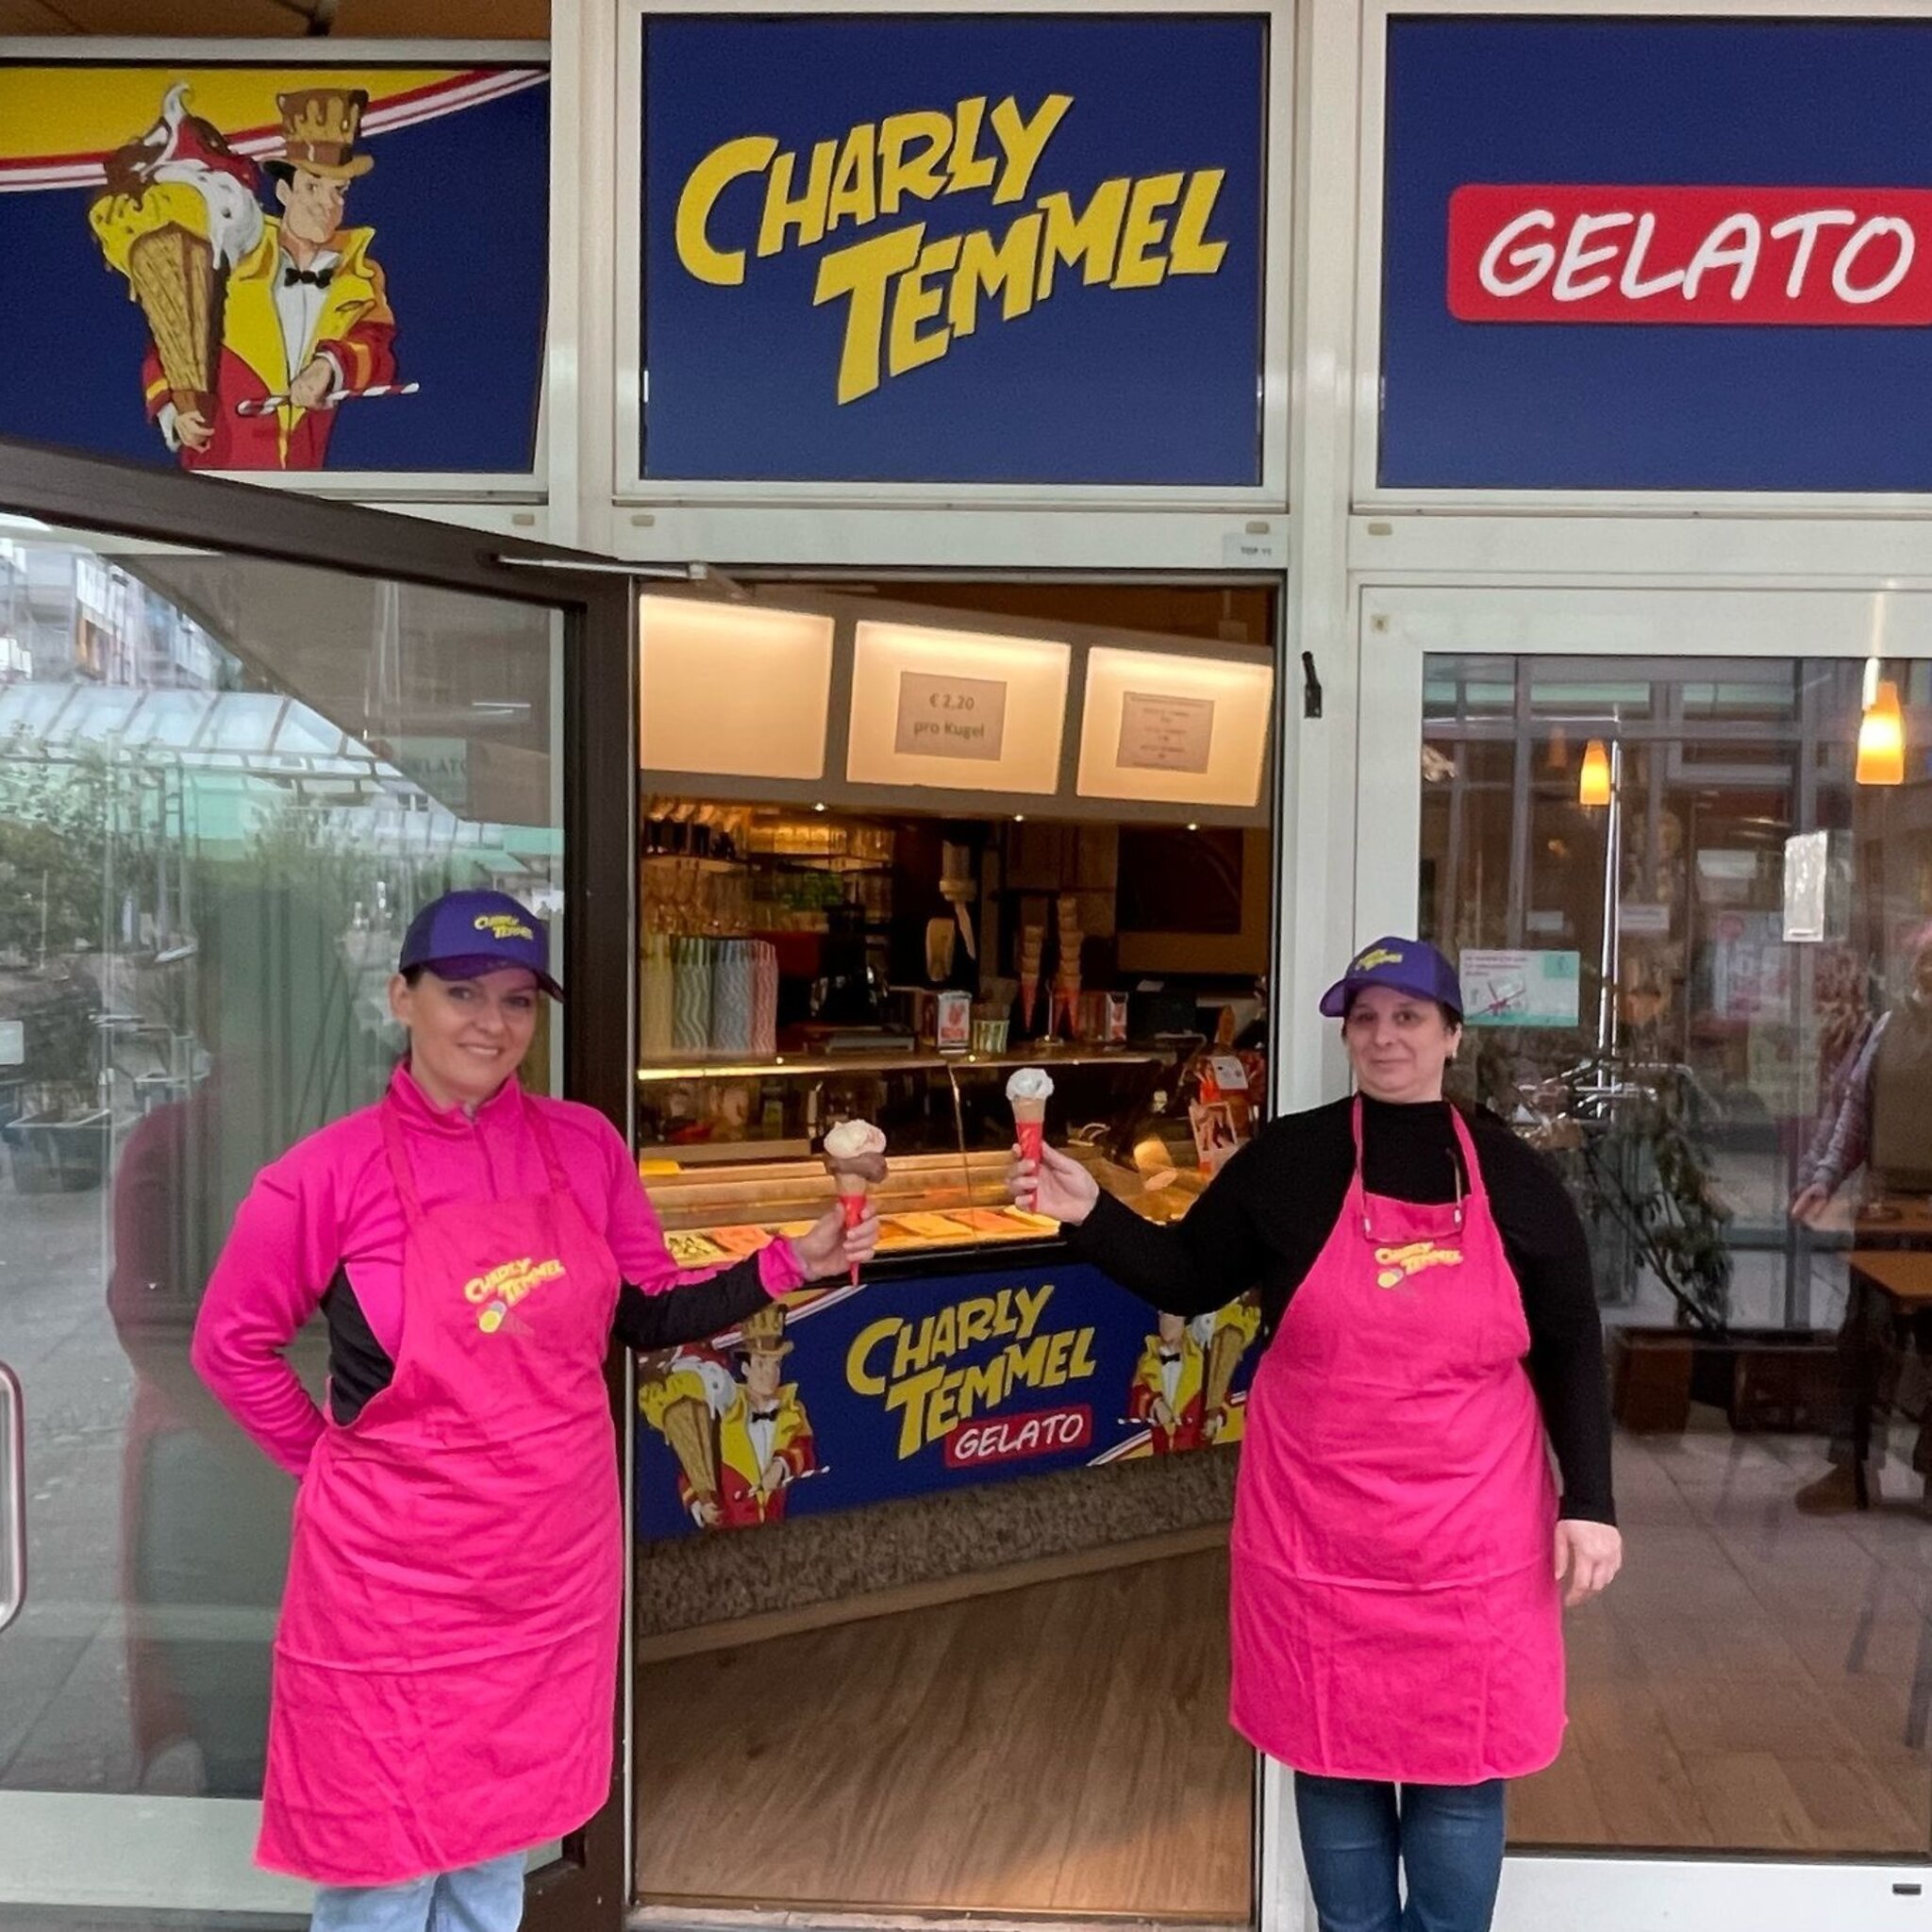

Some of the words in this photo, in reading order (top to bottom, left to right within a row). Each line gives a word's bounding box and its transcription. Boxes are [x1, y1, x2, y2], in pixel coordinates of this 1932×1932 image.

[675, 94, 1074, 285] CHARLY
[813, 169, 1228, 406] TEMMEL
[1478, 208, 1916, 304] GELATO
[913, 721, 940, 737] pro
[944, 720, 985, 741] Kugel
[929, 692, 941, 708] €
[846, 1284, 1055, 1395] CHARLY
[885, 1327, 1096, 1460] TEMMEL
[954, 1413, 1084, 1460] GELATO
